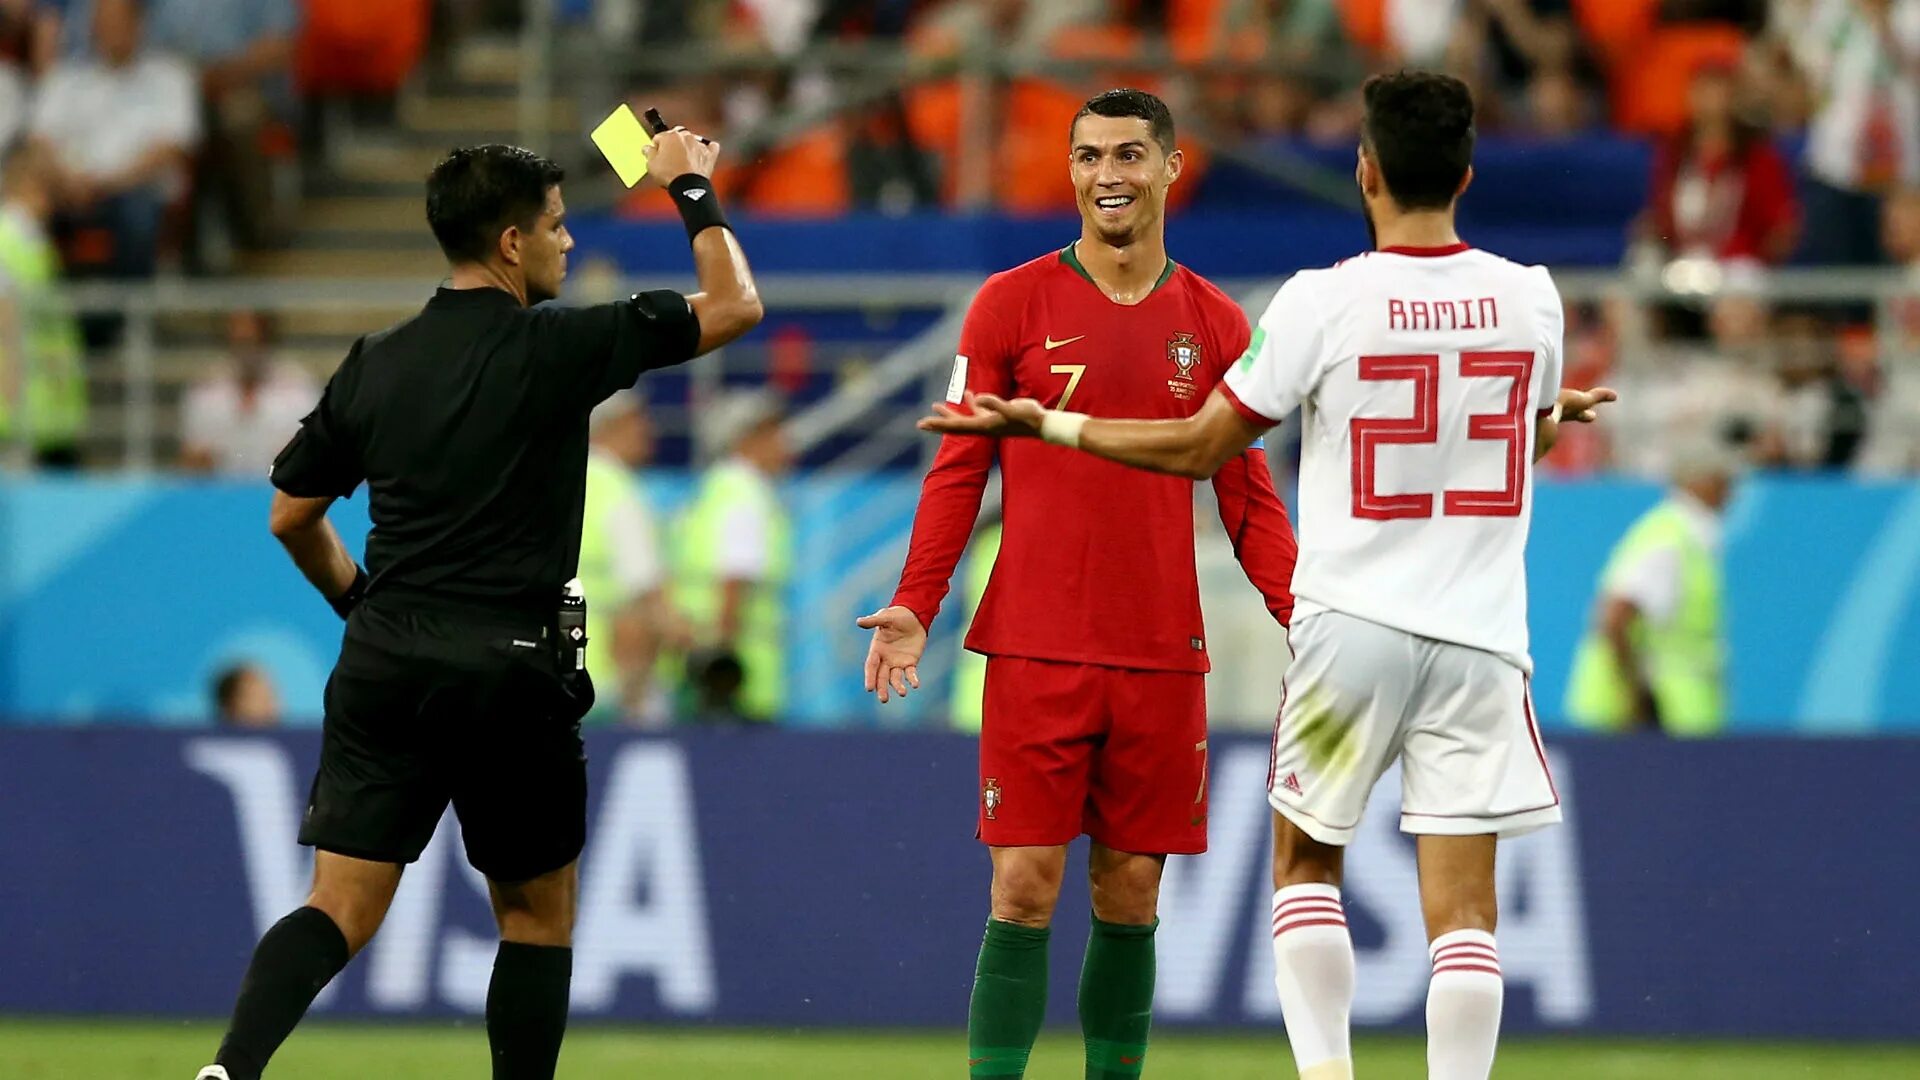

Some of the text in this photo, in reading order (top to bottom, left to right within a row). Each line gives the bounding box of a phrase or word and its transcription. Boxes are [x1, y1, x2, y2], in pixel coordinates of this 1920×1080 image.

[1388, 297, 1498, 331] RAMIN
[1050, 364, 1087, 412] 7
[1350, 351, 1535, 520] 23
